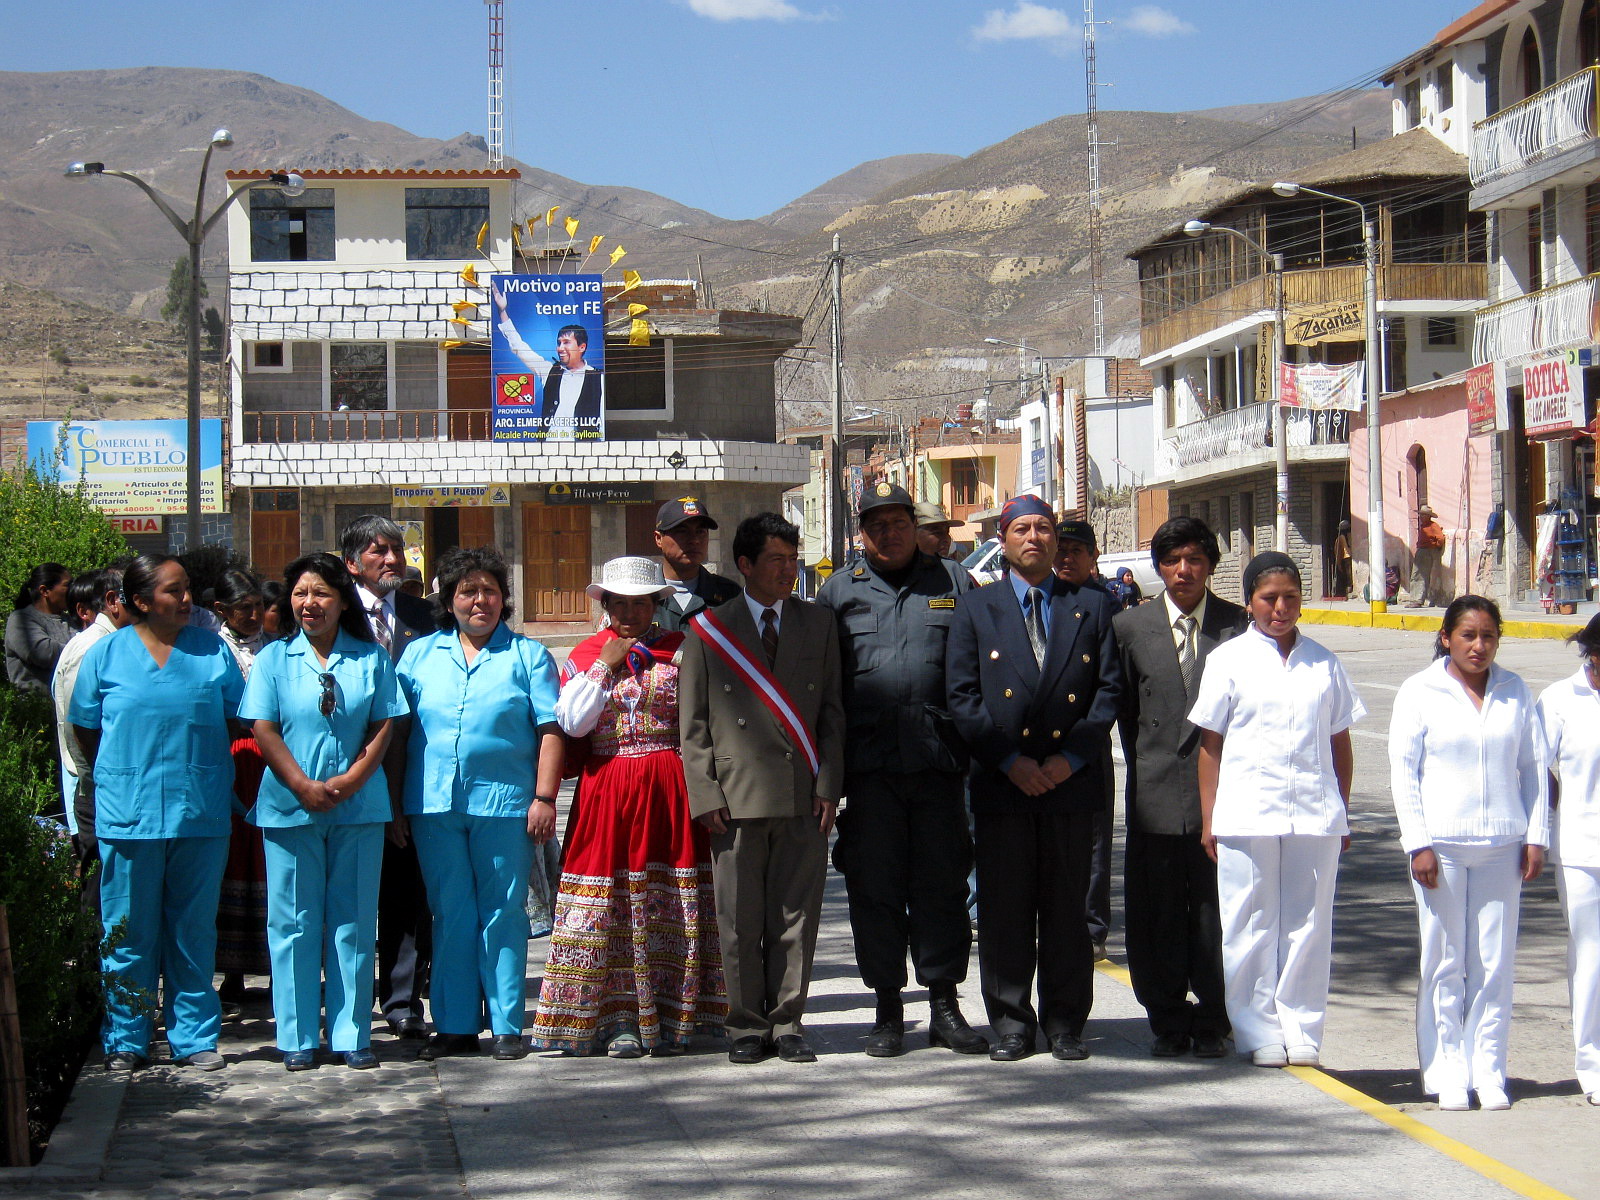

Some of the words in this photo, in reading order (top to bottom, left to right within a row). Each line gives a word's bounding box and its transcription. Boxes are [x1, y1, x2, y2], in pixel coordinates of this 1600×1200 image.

[503, 278, 561, 293] Motivo
[565, 281, 601, 296] para
[535, 302, 579, 315] tener
[583, 301, 601, 315] FE
[1343, 303, 1358, 312] DON
[1260, 323, 1268, 398] RESTAURANT
[1523, 359, 1570, 401] BOTICA
[1532, 401, 1542, 423] LOS
[1542, 396, 1567, 421] ANGELES
[495, 417, 515, 428] ARQ.
[516, 417, 543, 427] ELMER
[543, 414, 579, 427] CÁCERES
[77, 428, 151, 449] COMERCIAL
[155, 438, 169, 447] EL
[494, 430, 521, 439] Alcalde
[523, 430, 558, 439] Provincial
[560, 430, 569, 438] de
[78, 448, 186, 473] PUEBLO
[133, 489, 162, 497] Copias
[394, 487, 434, 498] Emporio
[162, 497, 215, 505] Imprenes
